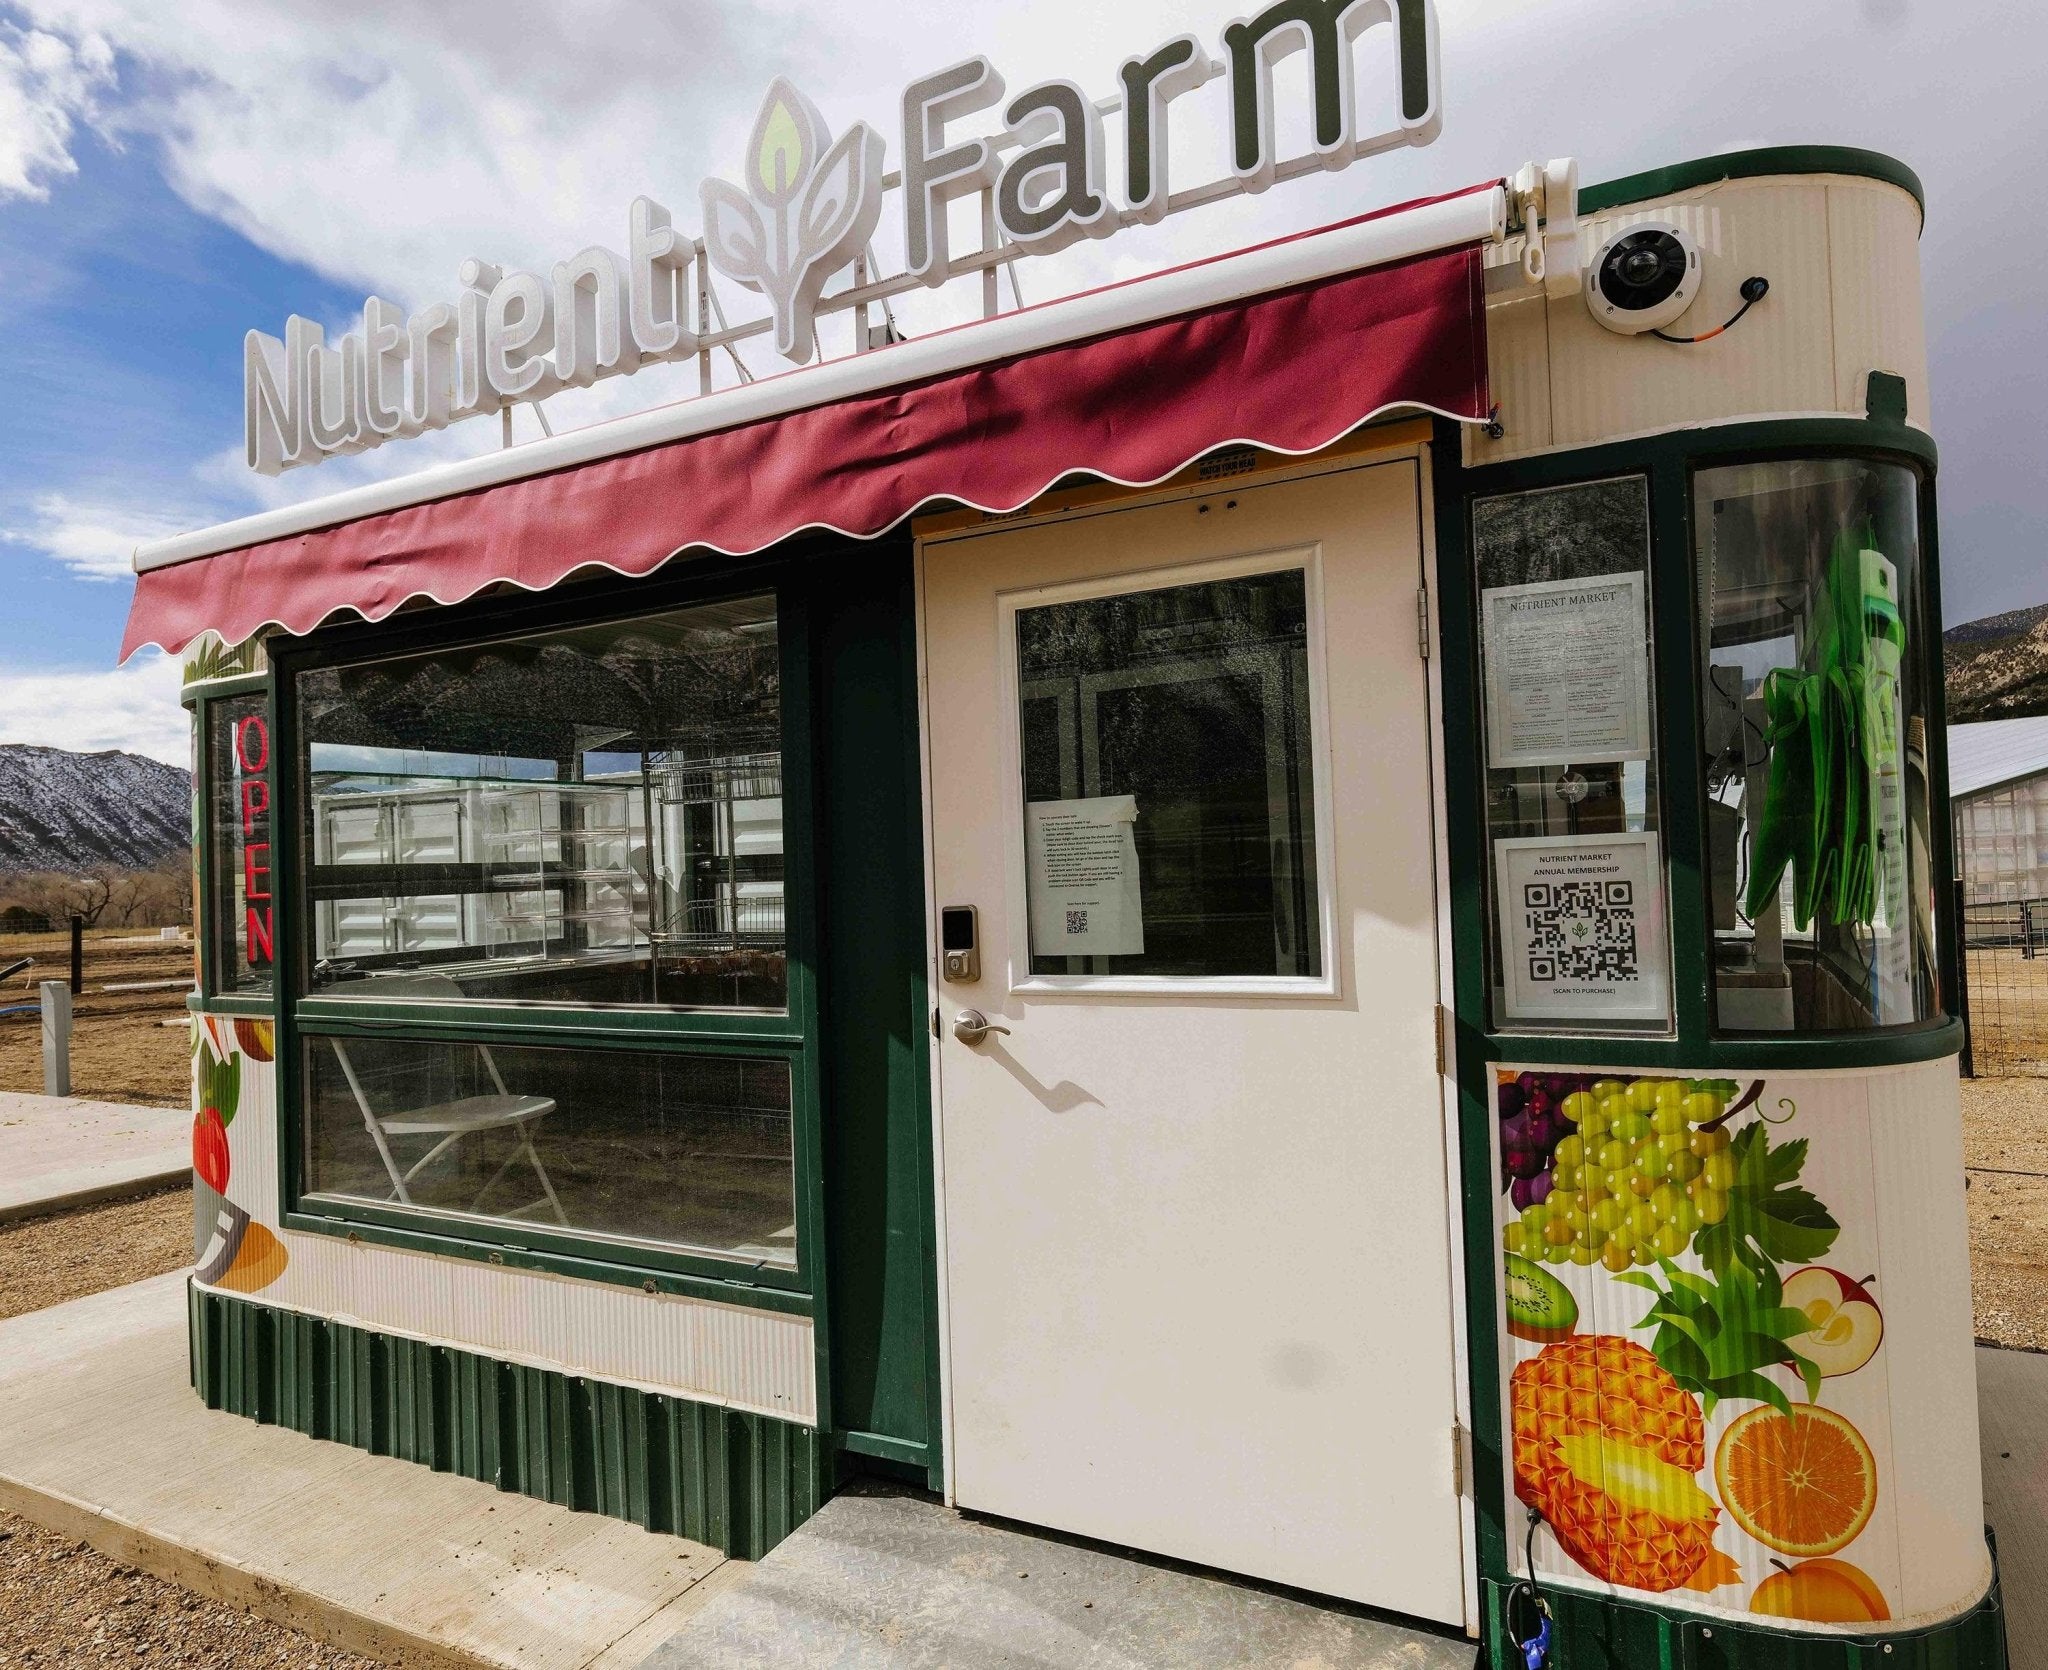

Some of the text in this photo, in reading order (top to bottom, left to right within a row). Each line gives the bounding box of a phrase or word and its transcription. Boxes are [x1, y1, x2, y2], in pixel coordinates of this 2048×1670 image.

[244, 0, 1442, 475] Nutrient Farm
[1510, 591, 1616, 612] NUTRIENT MARKET
[236, 715, 273, 965] OPEN
[1539, 853, 1612, 863] NUTRIENT MARKET
[1533, 866, 1620, 876] ANNUAL MEMBERSHIP
[1581, 987, 1616, 995] PURCHASE)
